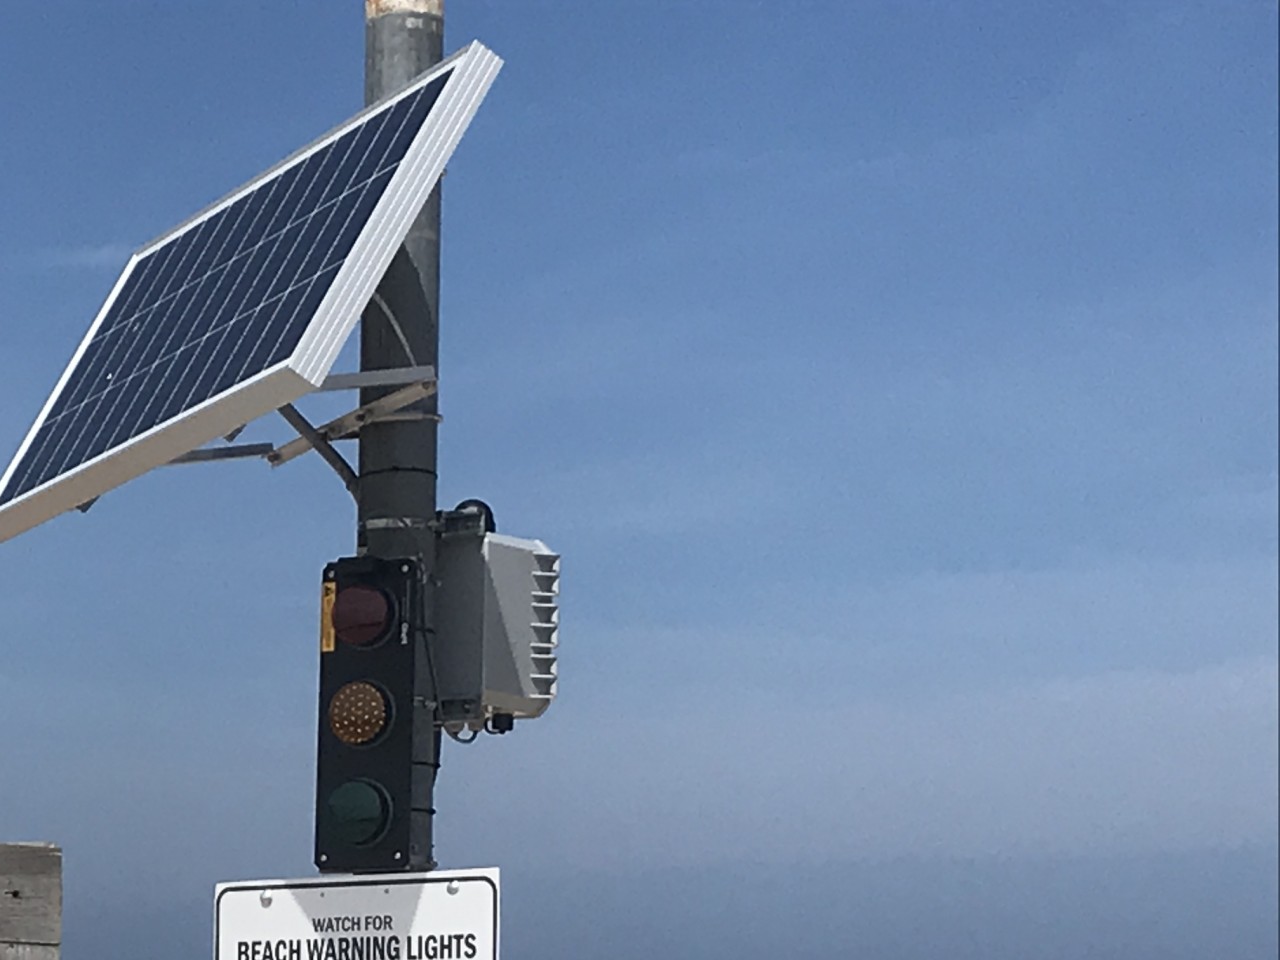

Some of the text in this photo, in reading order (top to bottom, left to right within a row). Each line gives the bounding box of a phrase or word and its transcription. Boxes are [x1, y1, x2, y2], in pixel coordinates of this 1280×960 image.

[311, 914, 393, 933] WATCH FOR
[406, 933, 477, 960] LIGHTS
